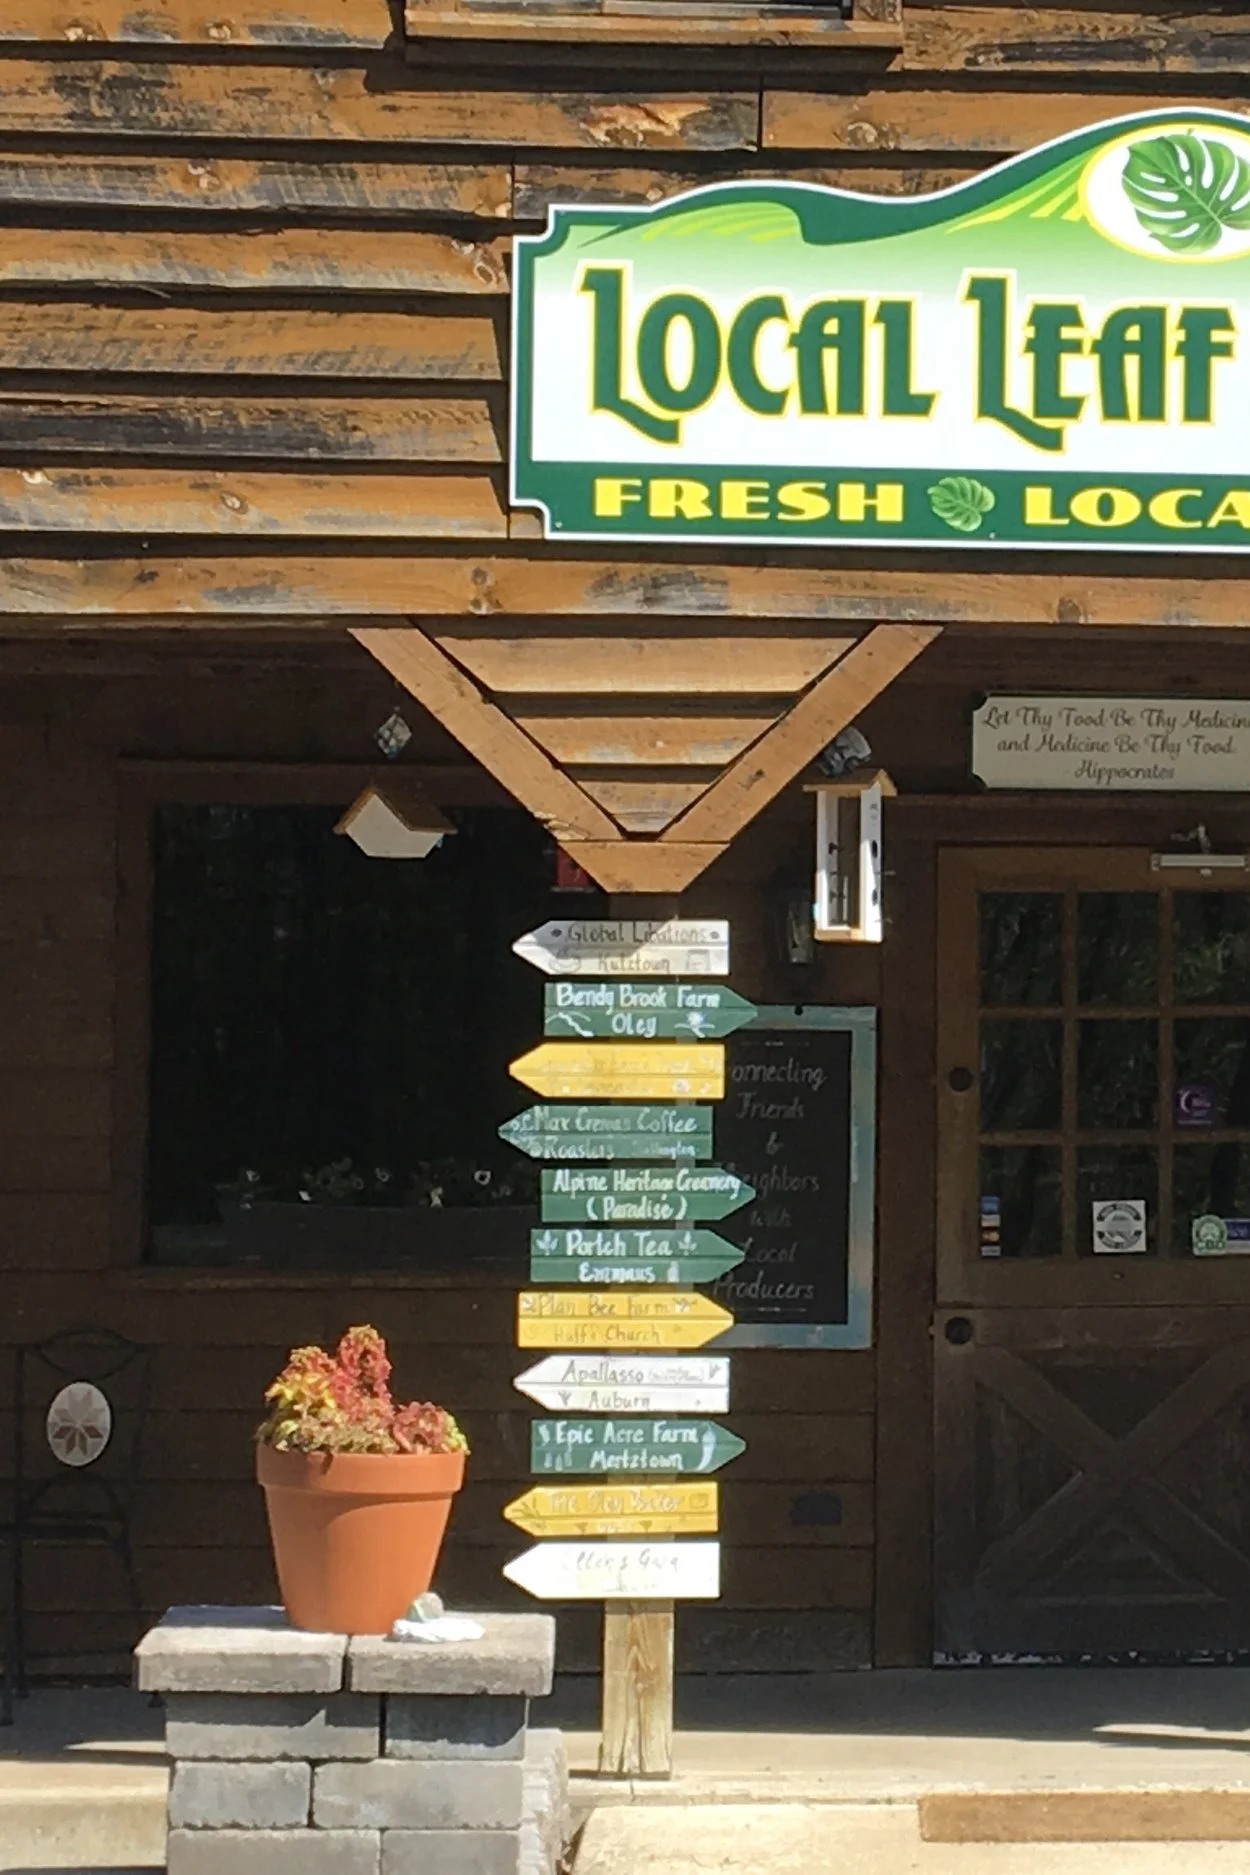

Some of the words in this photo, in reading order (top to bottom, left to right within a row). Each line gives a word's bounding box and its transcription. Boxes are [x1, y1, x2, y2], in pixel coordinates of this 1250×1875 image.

[594, 477, 905, 522] FRESH
[982, 706, 1010, 730] Let
[1016, 706, 1052, 733] Thy
[1058, 707, 1105, 728] Food
[1110, 707, 1134, 728] Be
[1141, 707, 1177, 734] Thy
[997, 733, 1029, 752] and
[1035, 732, 1111, 753] Medicine
[1114, 734, 1139, 754] Be
[1144, 734, 1181, 760] Thy
[1073, 758, 1175, 785] Hippocrates
[567, 922, 624, 944] Global
[598, 952, 671, 973] Kutztown
[556, 983, 614, 1014] Bendy
[620, 984, 667, 1008] Brook
[677, 985, 720, 1008] Farm
[612, 1013, 657, 1037] Oley
[732, 1058, 827, 1091] onnecting
[736, 1090, 804, 1120] Friends
[637, 1106, 698, 1132] Coffee
[544, 1136, 614, 1160] Roasters
[553, 1168, 607, 1198] Alpine
[676, 1168, 741, 1200] Creamery
[633, 1231, 672, 1256] Tea
[743, 1237, 798, 1263] Local
[579, 1261, 655, 1283] Emmaus
[589, 1294, 616, 1316] Bee
[628, 1295, 668, 1316] Farm
[604, 1322, 660, 1344] Church
[588, 1390, 651, 1409] Auburn
[556, 1421, 593, 1447] Epic
[603, 1421, 645, 1444] Acre
[652, 1421, 699, 1445] Farm
[590, 1449, 684, 1471] Mertztown
